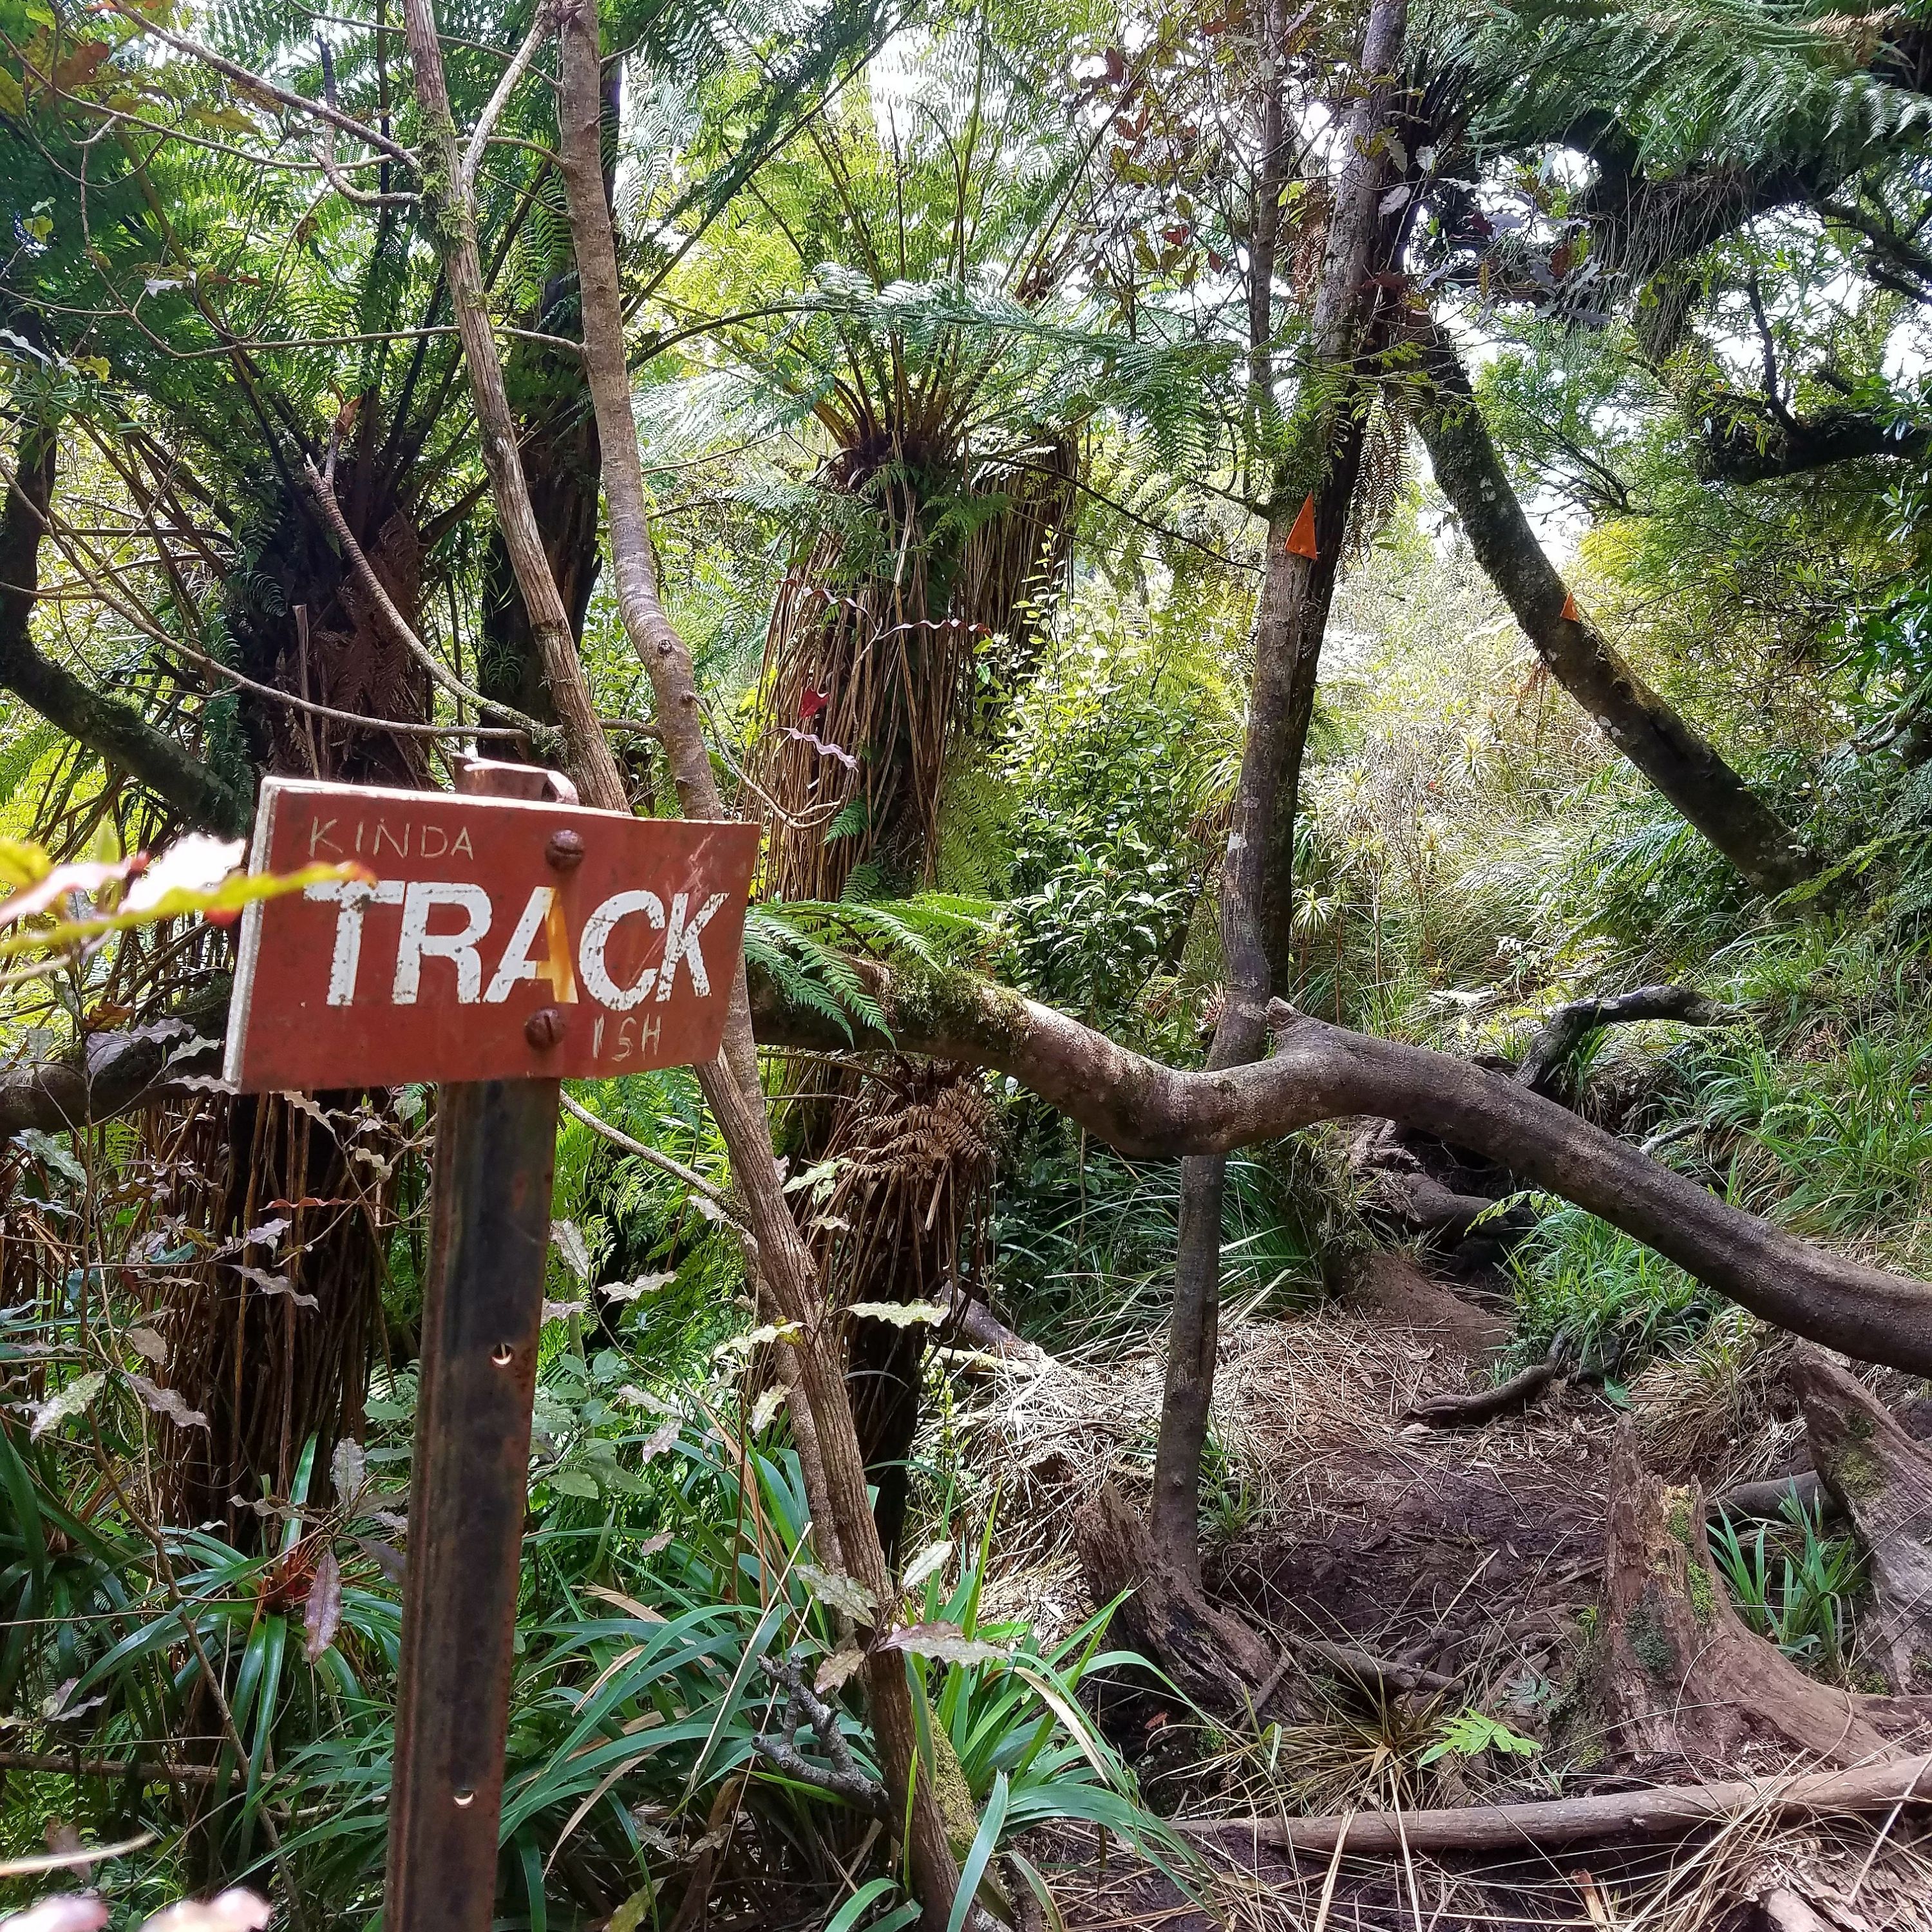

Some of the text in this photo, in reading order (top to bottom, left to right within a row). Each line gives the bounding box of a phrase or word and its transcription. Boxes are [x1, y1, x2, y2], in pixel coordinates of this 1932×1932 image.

[308, 816, 473, 860] KINDA
[303, 880, 730, 1011] TRACK
[592, 1013, 661, 1061] ISH
